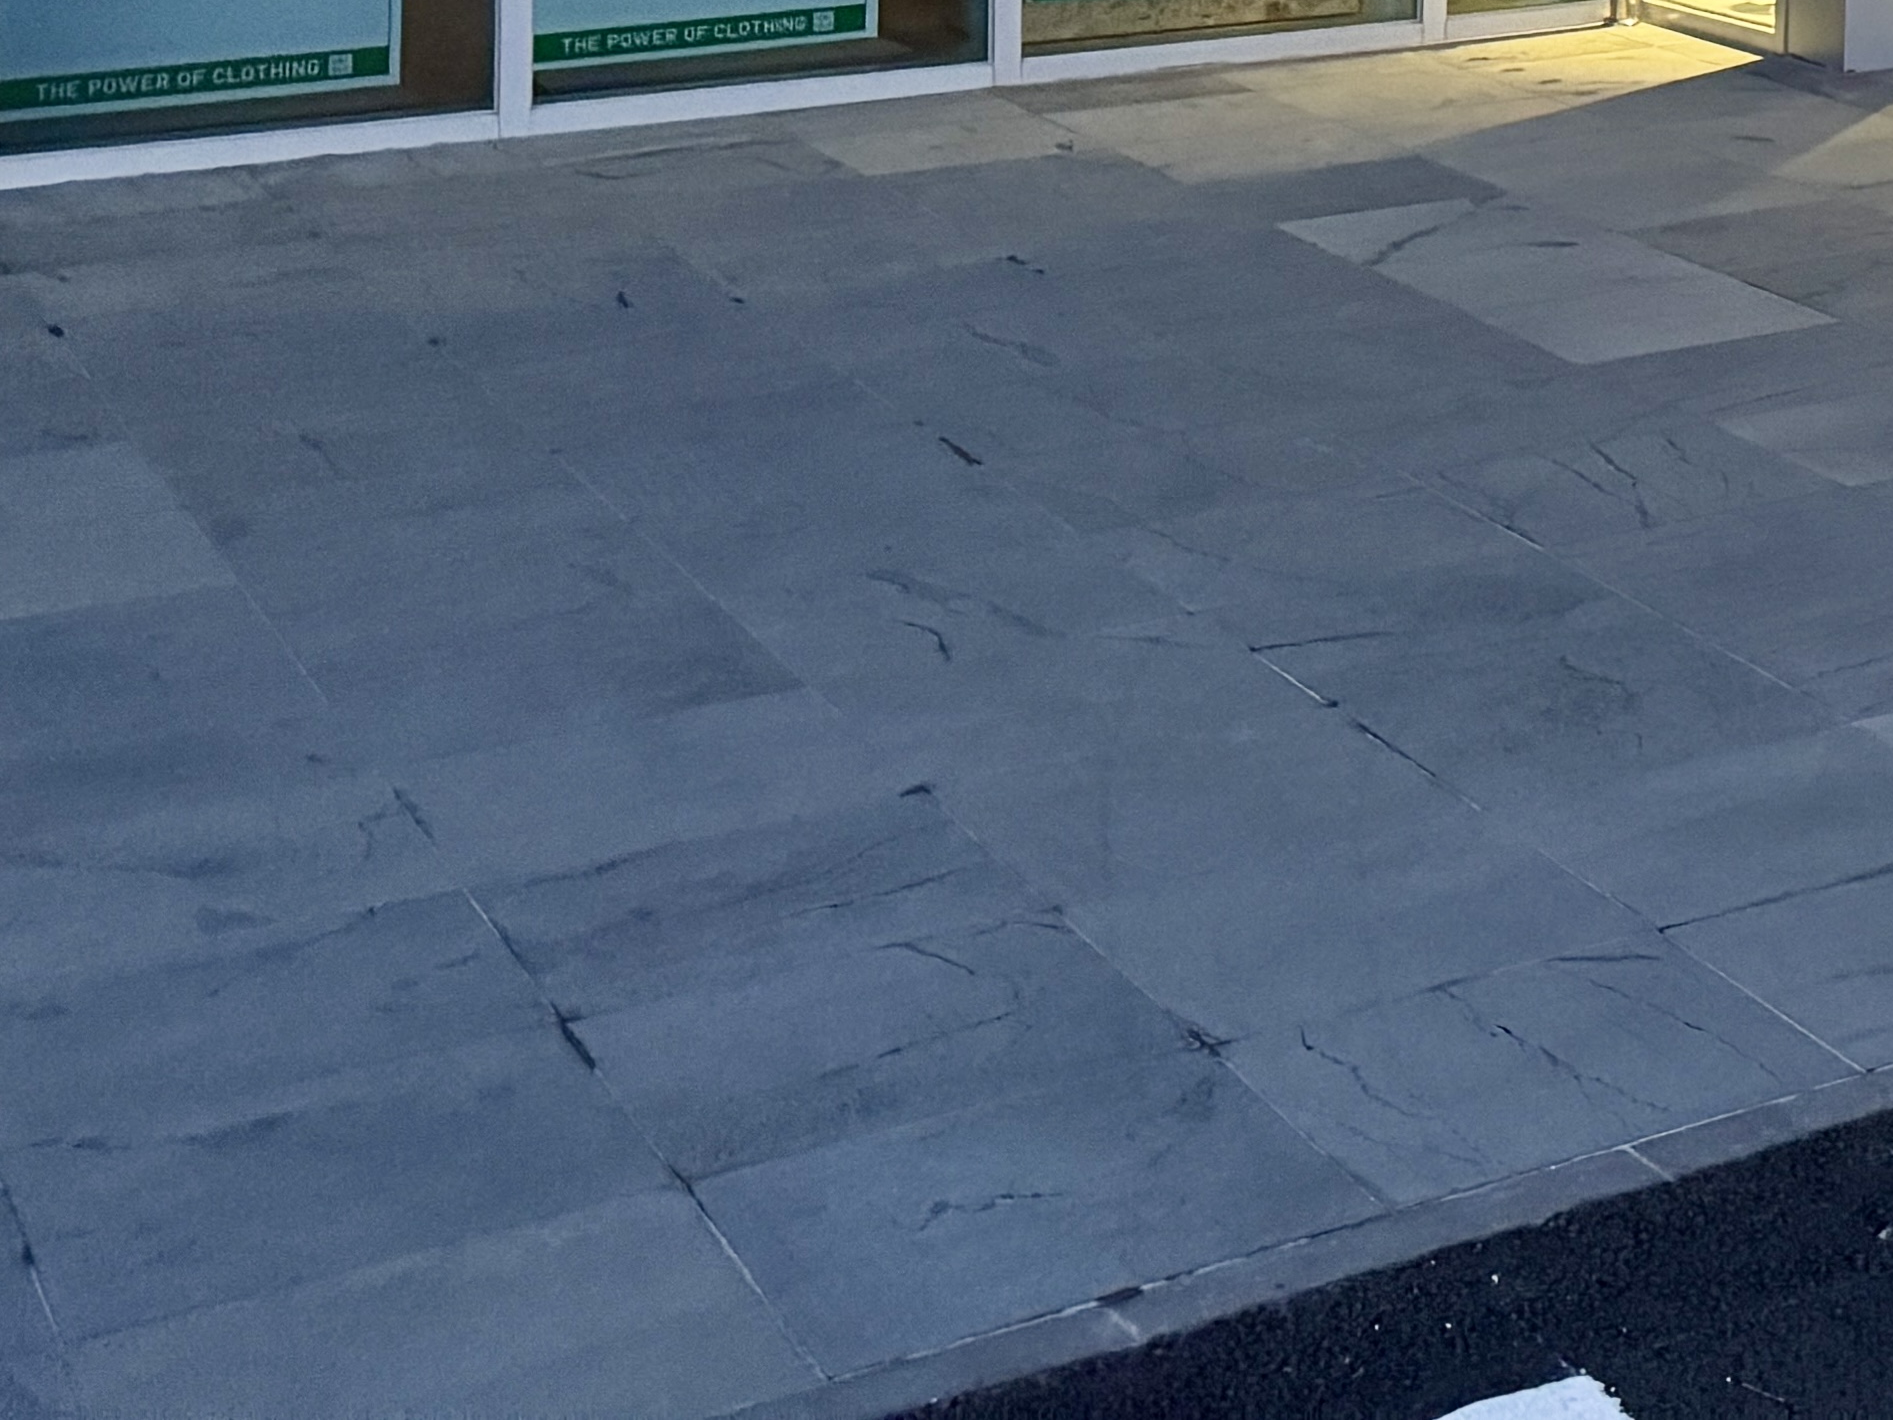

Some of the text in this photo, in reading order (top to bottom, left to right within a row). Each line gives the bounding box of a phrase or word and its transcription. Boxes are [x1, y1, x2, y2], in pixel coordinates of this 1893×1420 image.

[561, 34, 601, 56] THE
[607, 28, 678, 51] POWER
[684, 25, 712, 42] OF
[713, 16, 808, 39] CLOTHING
[36, 80, 80, 101] THE
[87, 72, 170, 97] POWER
[176, 68, 208, 88] OF
[212, 59, 320, 85] CLOTHING
